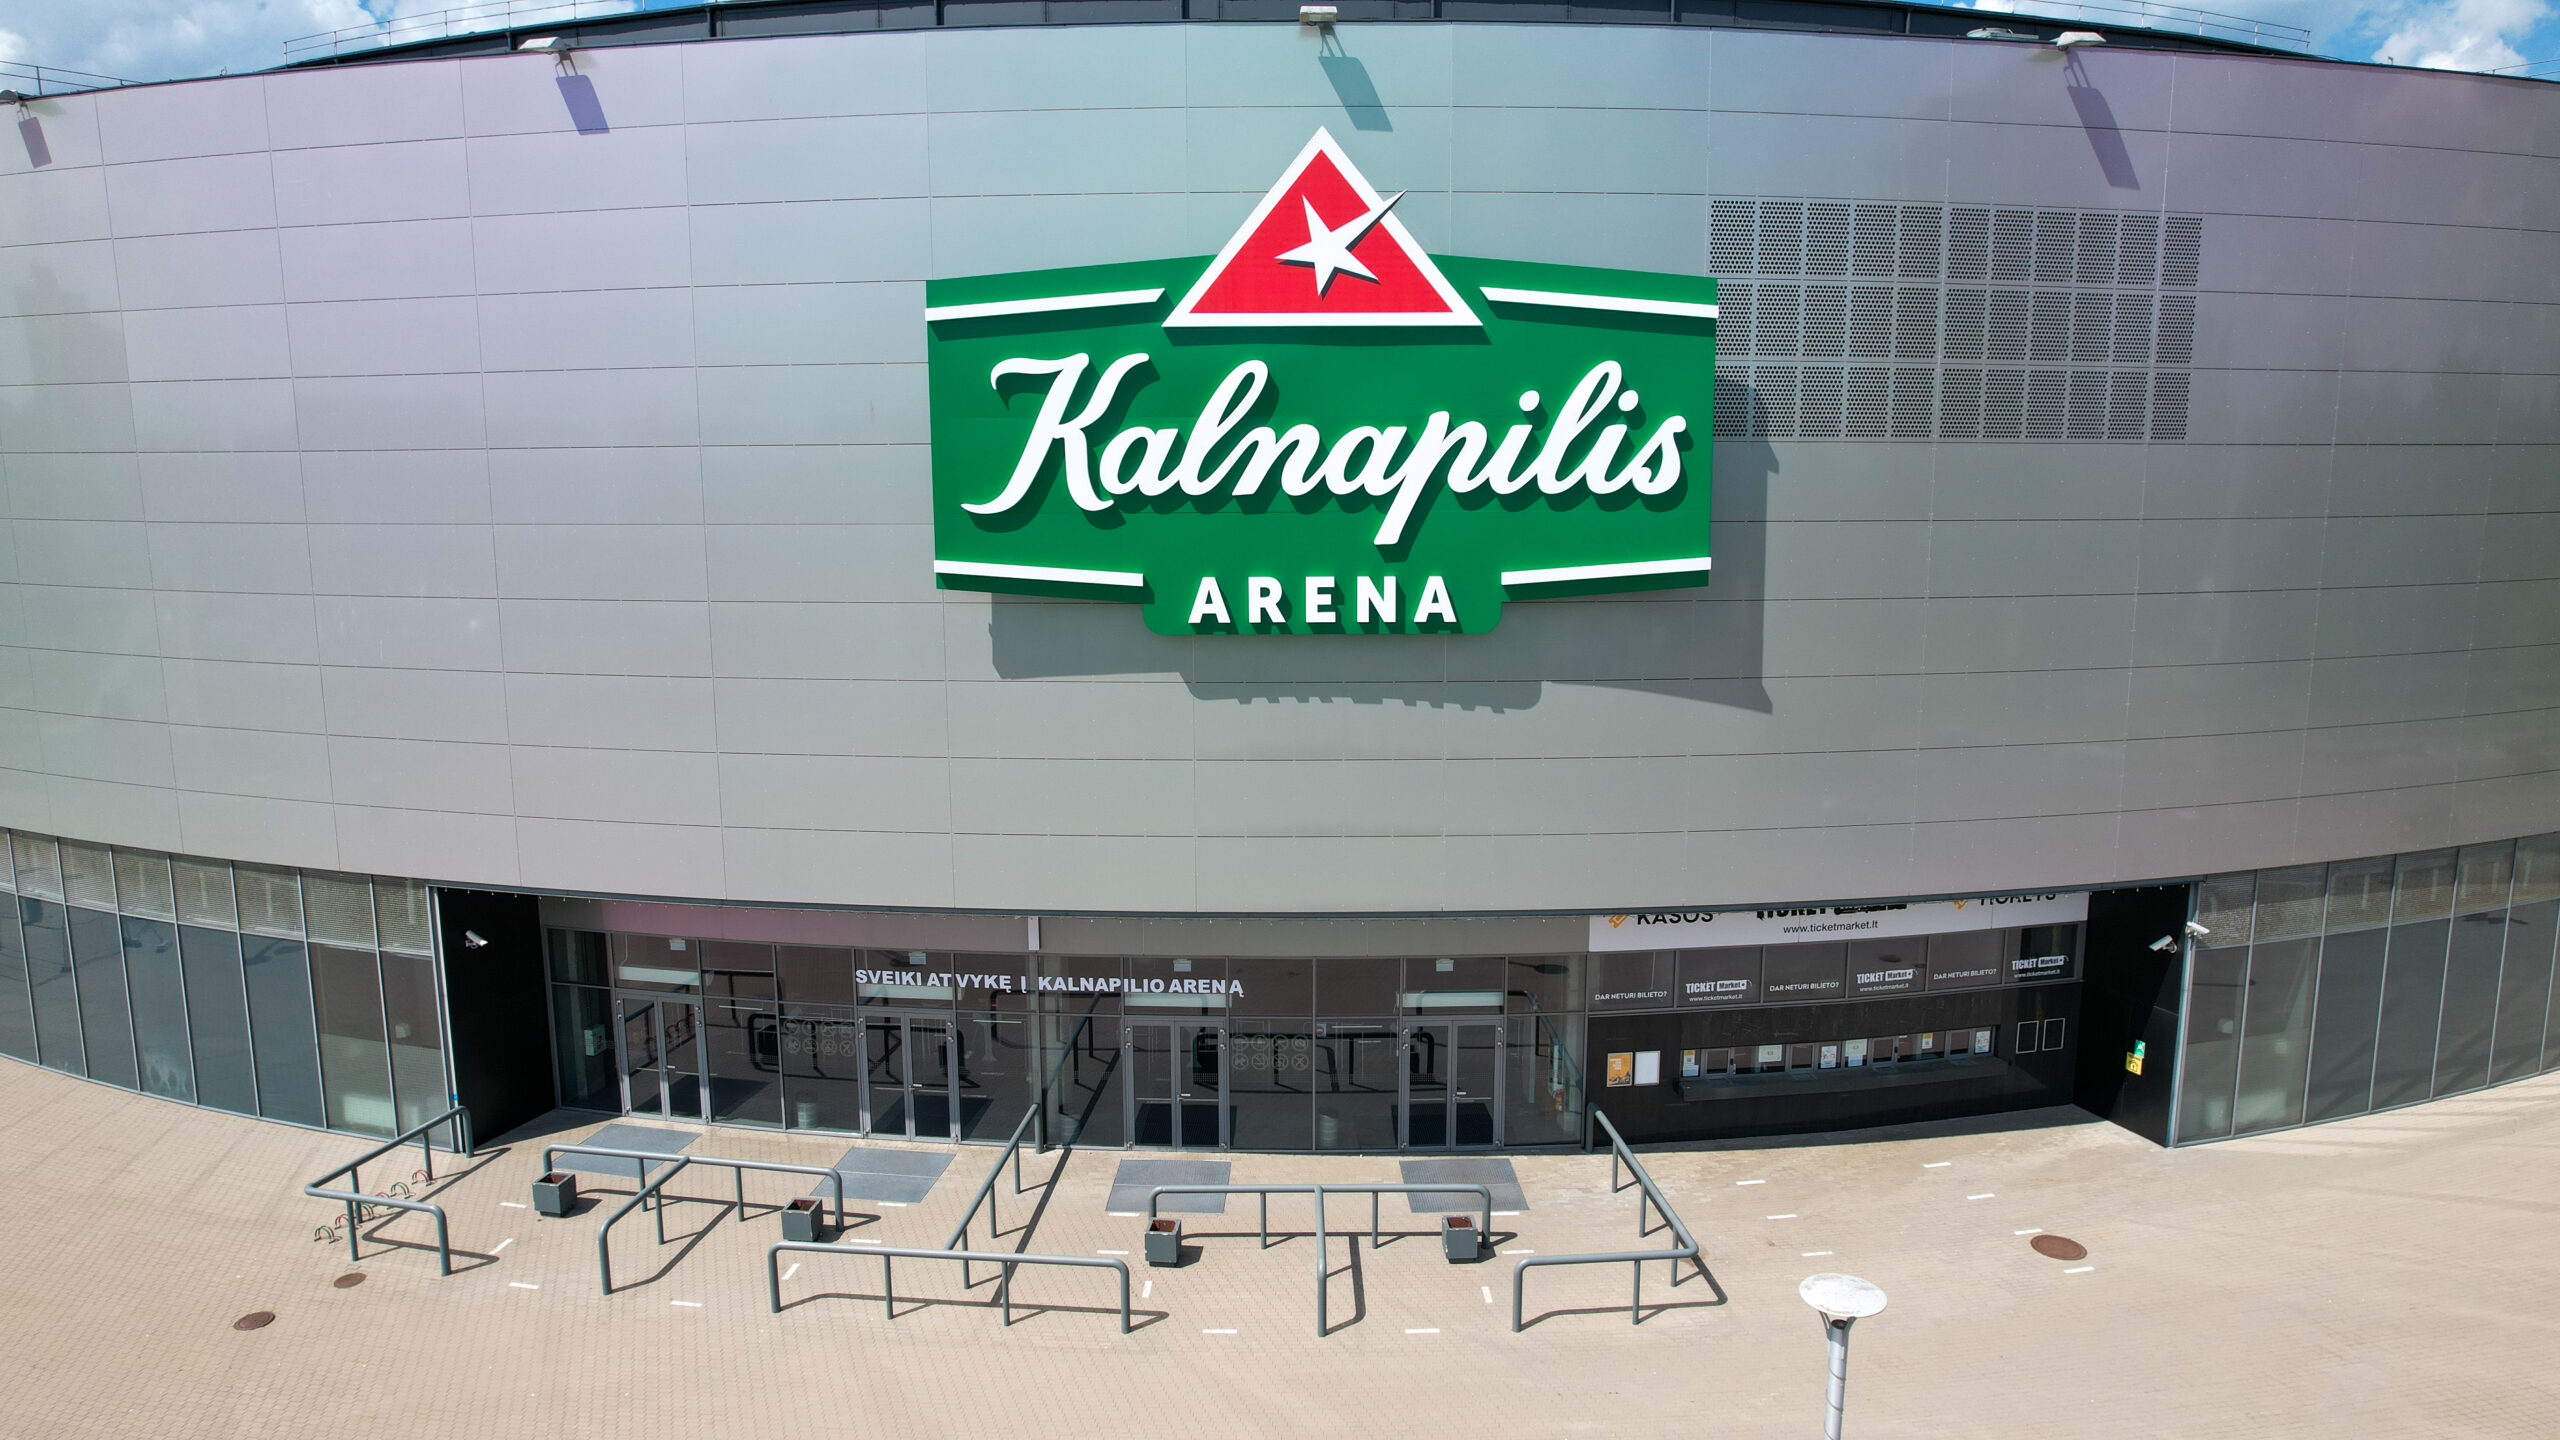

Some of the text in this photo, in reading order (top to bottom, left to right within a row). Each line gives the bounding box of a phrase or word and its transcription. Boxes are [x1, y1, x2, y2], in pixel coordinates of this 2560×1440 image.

[961, 352, 1687, 546] Kalnapilis
[1188, 575, 1457, 624] ARENA
[1783, 920, 1878, 934] www.ticketmarket.lt
[2012, 958, 2037, 970] TICKET
[1857, 971, 1884, 984] TICKET
[1947, 971, 1970, 979] NETURI
[855, 969, 922, 986] SVEIKI
[1020, 976, 1028, 993] Į
[1038, 977, 1165, 993] KALNAPILIO
[1168, 979, 1245, 998] ARENĄ
[1686, 982, 1715, 994] TICKET
[1769, 981, 1839, 992] DAR NETURI BILIETO?
[1611, 992, 1637, 1000] NETURI
[1637, 991, 1668, 999] BILIETO?
[1689, 994, 1743, 1002] www.ticketmarket.lt
